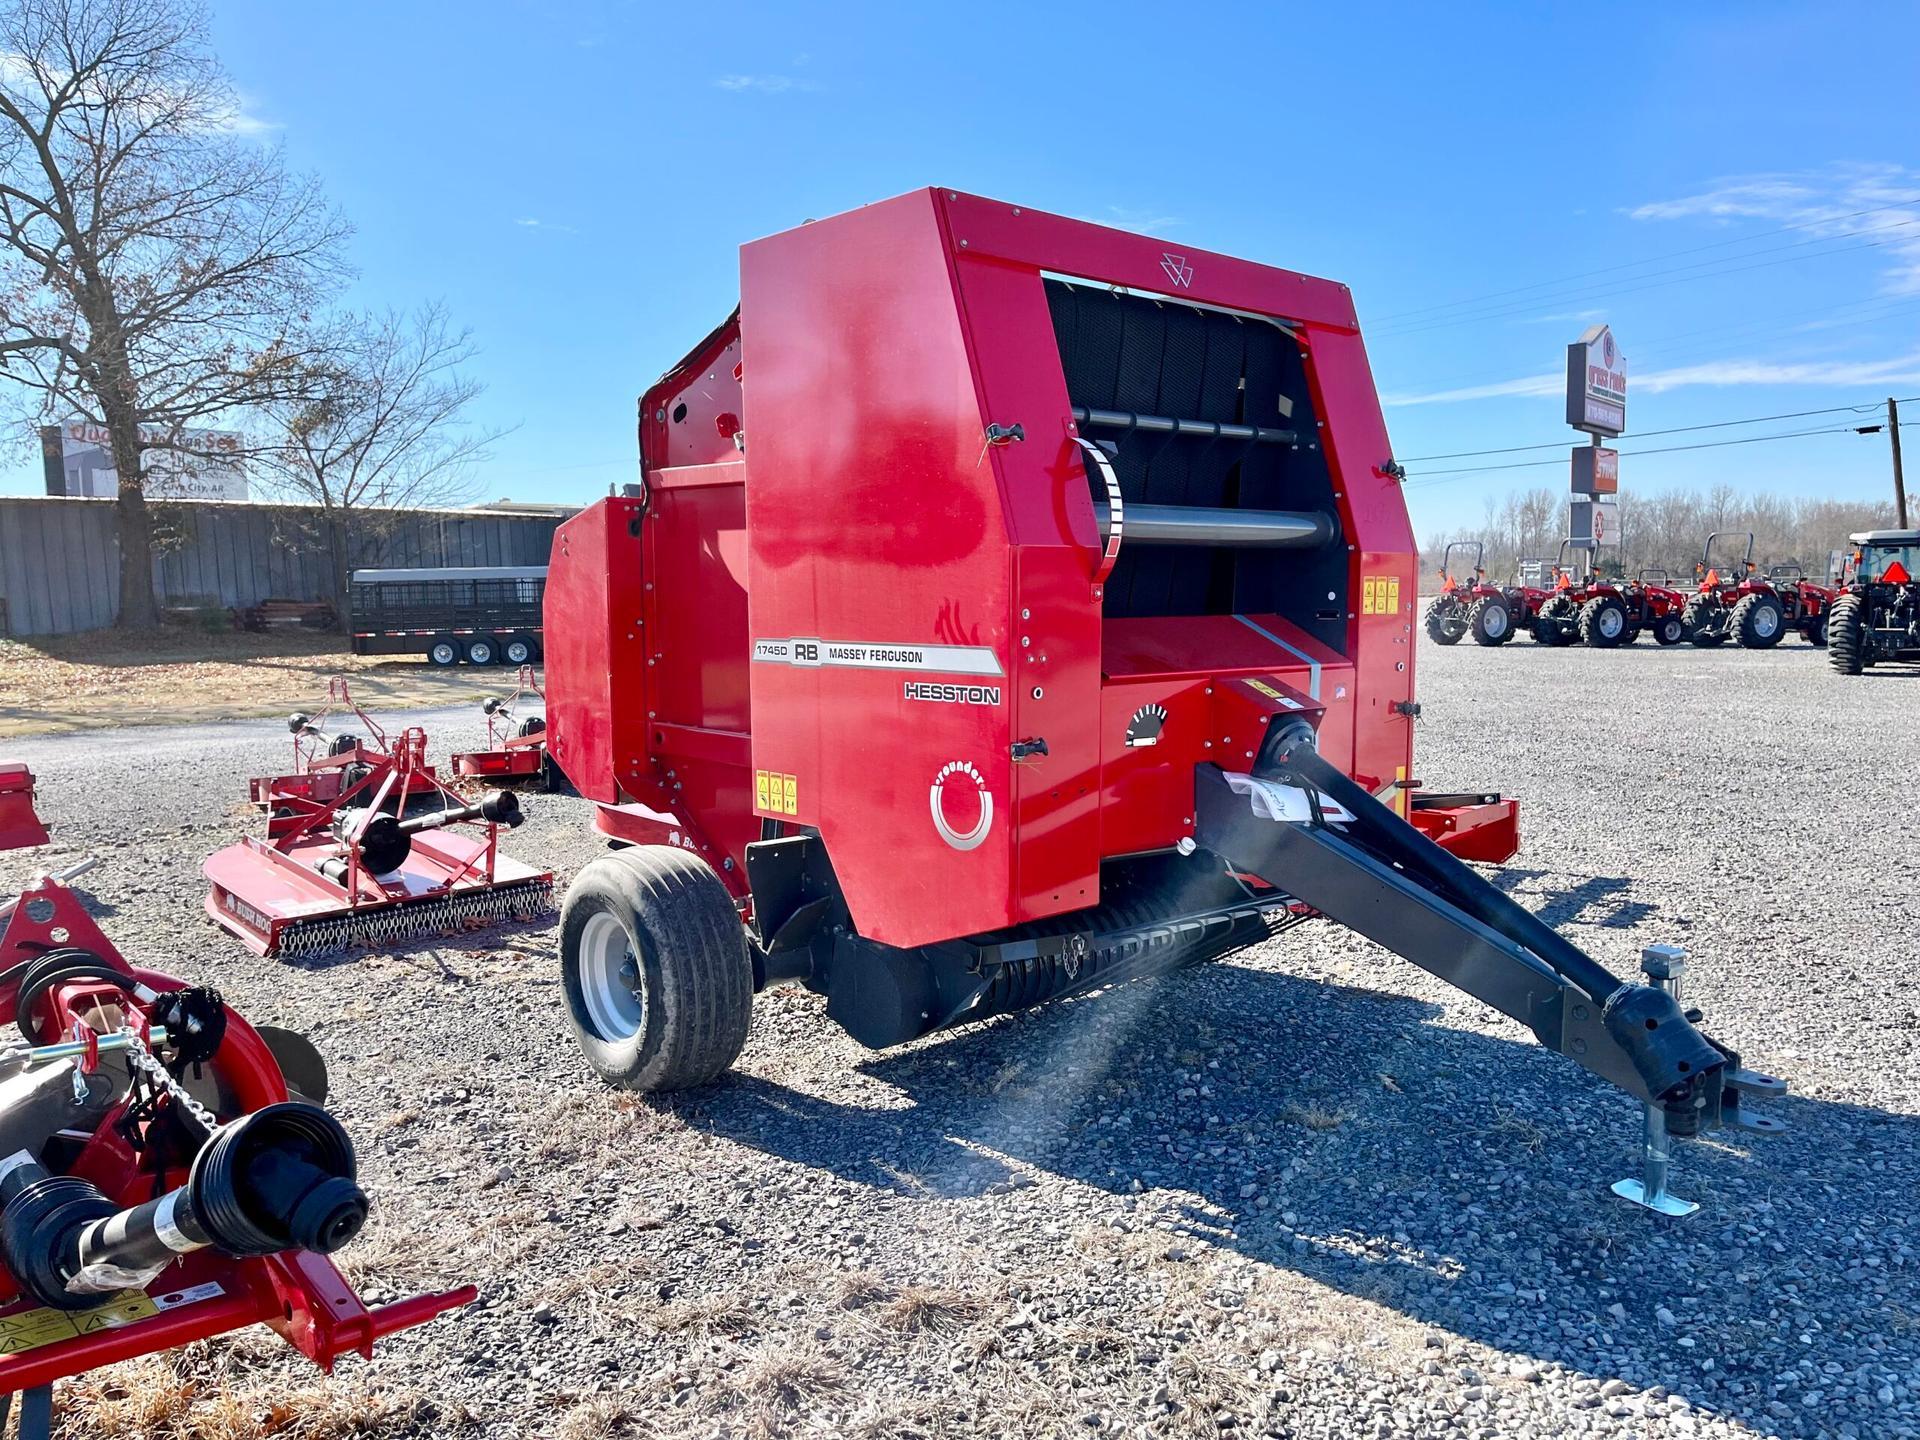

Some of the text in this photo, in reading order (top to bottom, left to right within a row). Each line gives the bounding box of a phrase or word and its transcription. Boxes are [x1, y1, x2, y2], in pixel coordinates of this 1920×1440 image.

[1596, 462, 1616, 480] STIHL
[188, 483, 209, 493] City,
[212, 484, 224, 492] AR
[756, 644, 923, 664] 1745D RB MASSEY FERGUSON
[904, 682, 1000, 705] HESSTON
[936, 760, 985, 785] rounder
[236, 900, 272, 936] BUSH HOG
